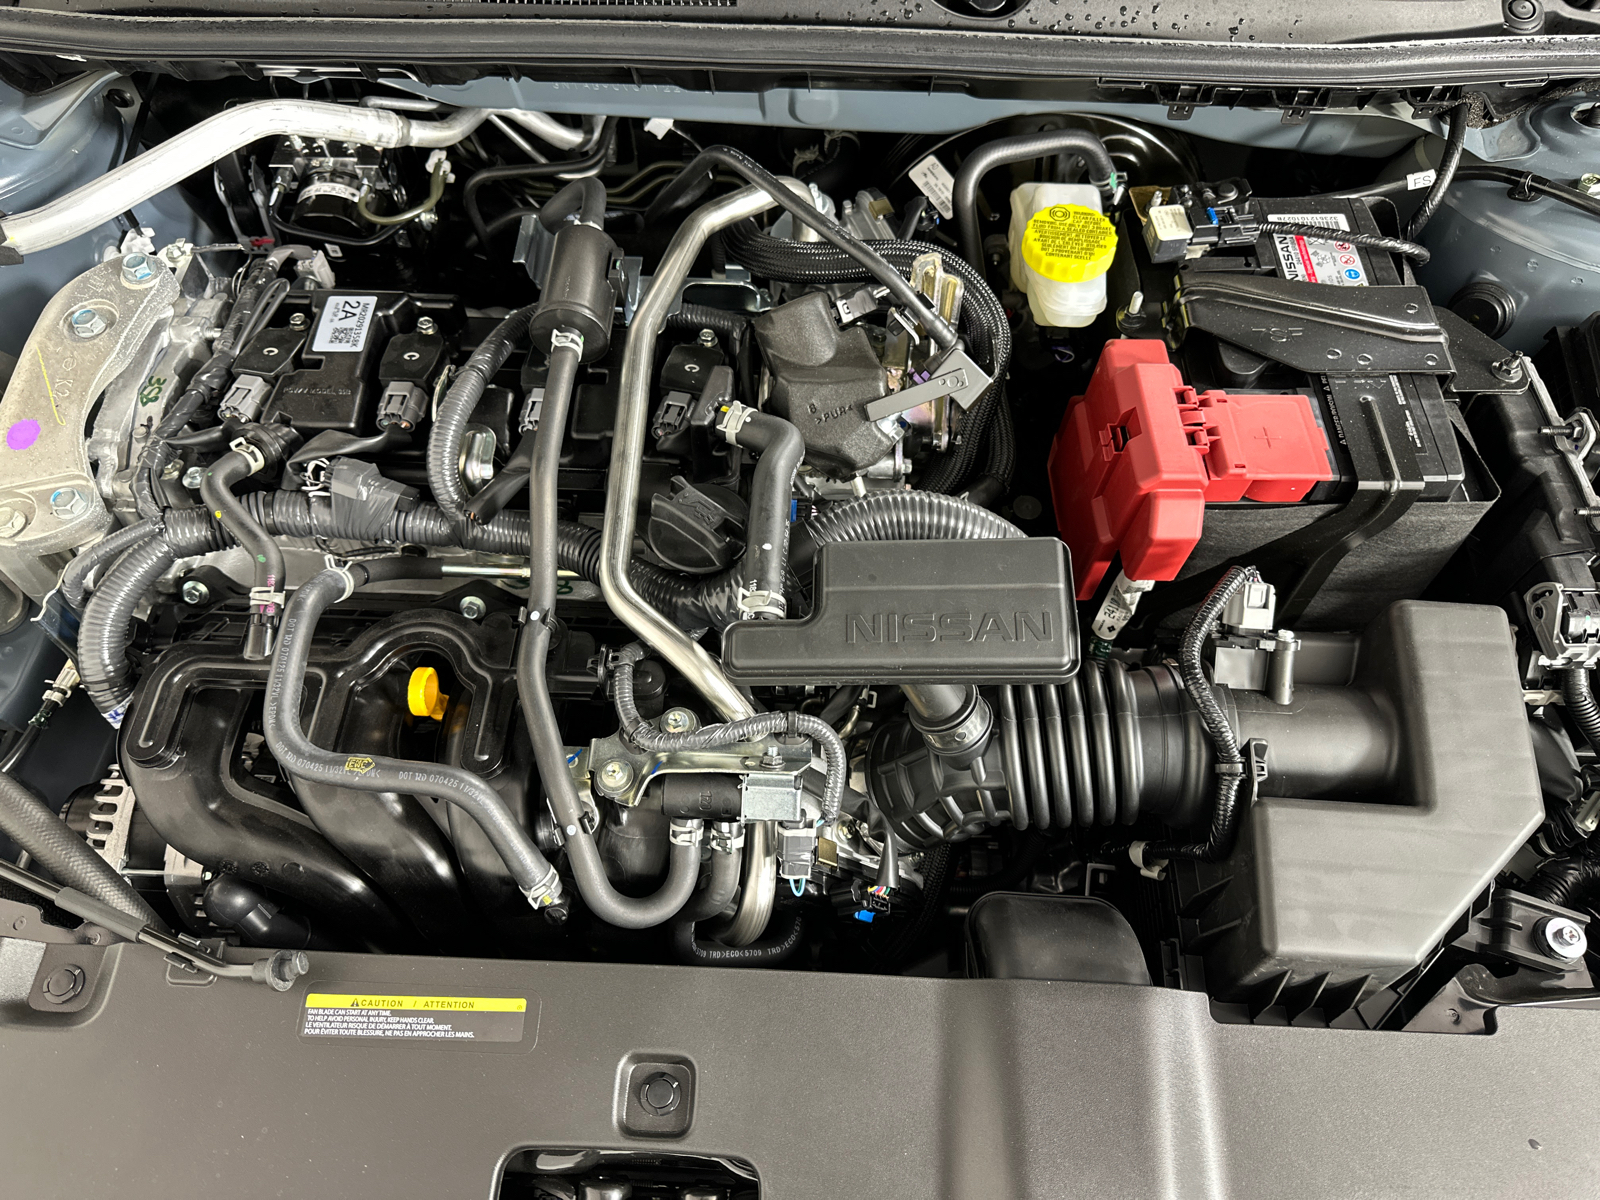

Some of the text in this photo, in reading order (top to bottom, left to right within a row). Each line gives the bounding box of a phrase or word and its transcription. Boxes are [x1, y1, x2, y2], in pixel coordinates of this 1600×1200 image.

[1414, 175, 1432, 187] FS
[1277, 236, 1298, 280] NISSAN
[338, 301, 361, 321] 2A
[288, 618, 296, 632] DOT
[846, 612, 1054, 643] NISSAN
[276, 741, 288, 755] DOT
[297, 759, 323, 772] 070425
[399, 771, 412, 780] DOT
[430, 775, 459, 788] 070425
[709, 950, 762, 959] TRD>ECO<5709
[361, 1000, 403, 1008] CAUTION
[423, 1000, 475, 1009] ATTENTION
